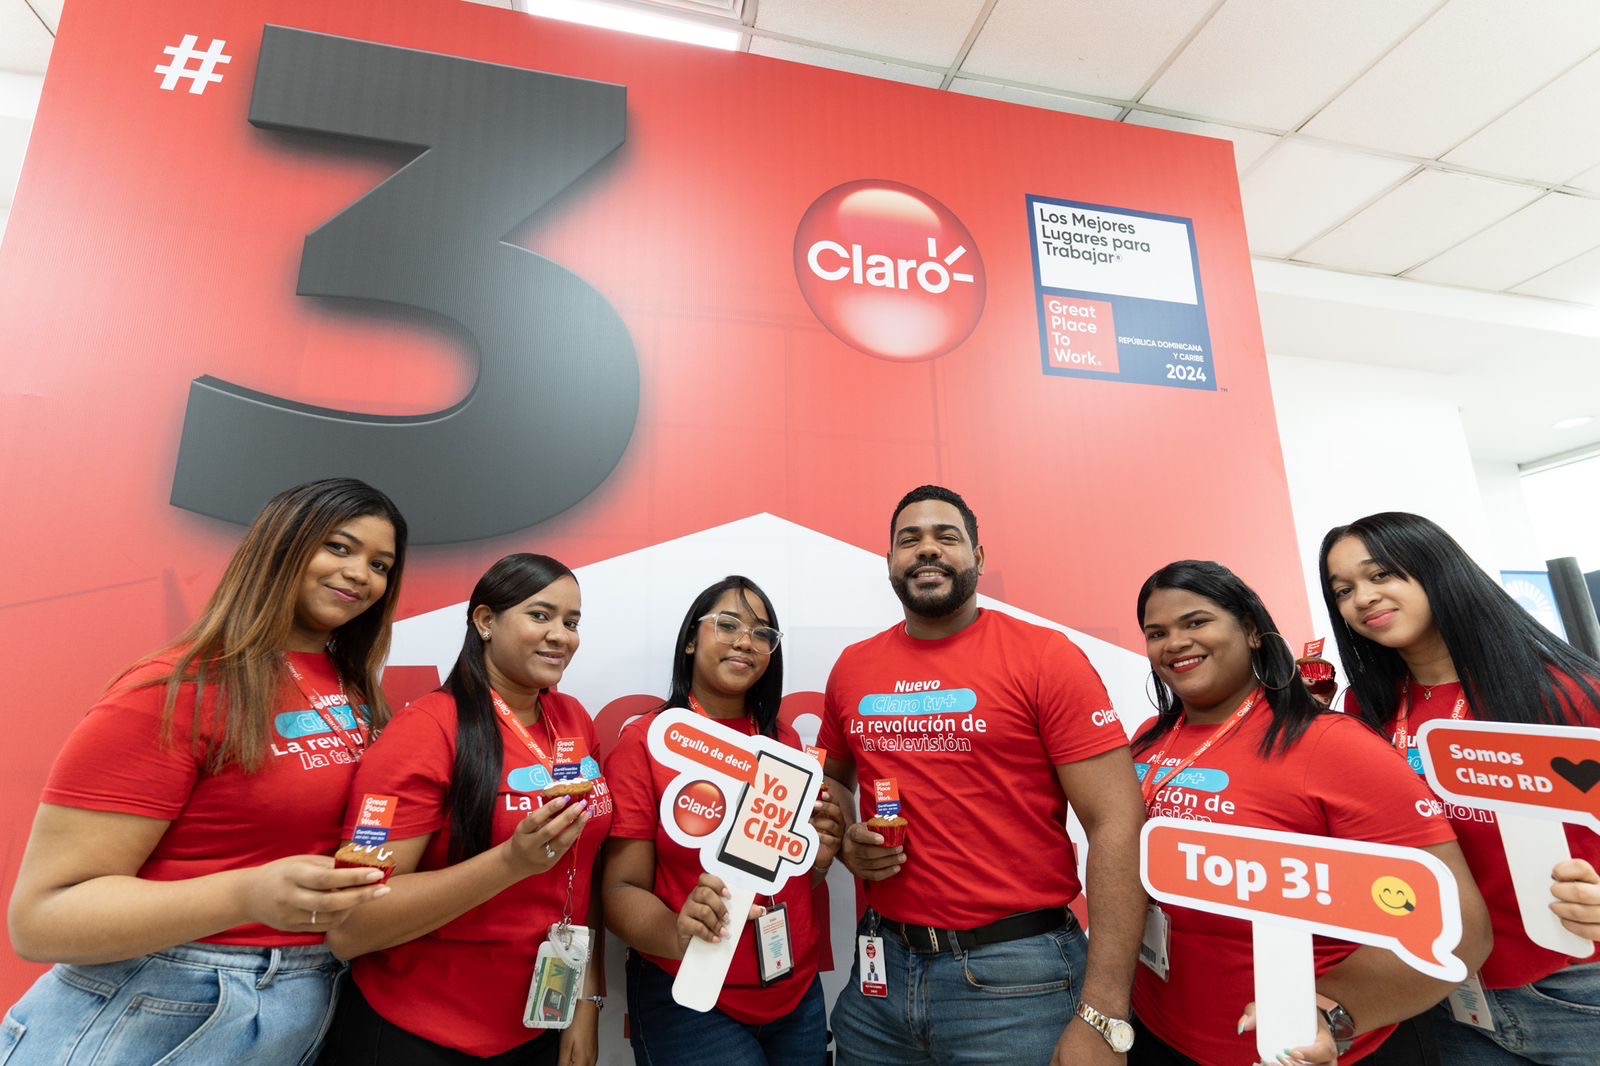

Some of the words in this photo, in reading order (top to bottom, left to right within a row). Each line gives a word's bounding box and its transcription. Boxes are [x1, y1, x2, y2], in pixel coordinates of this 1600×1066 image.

[1040, 208, 1068, 225] Los
[1072, 213, 1136, 234] Mejores
[1042, 225, 1108, 247] Lugares
[1112, 237, 1151, 252] para
[808, 237, 974, 294] Claro
[1049, 300, 1096, 319] Great
[1052, 315, 1097, 334] Place
[1052, 332, 1071, 346] To
[1118, 336, 1157, 347] REPÚBLICA
[1158, 340, 1203, 352] DOMINICANA
[1173, 352, 1179, 360] Y
[1179, 353, 1204, 362] CARIBE
[1166, 364, 1207, 382] 2024
[894, 680, 940, 693] Nuevo
[872, 696, 920, 712] Claro
[850, 719, 864, 734] La
[868, 715, 956, 733] revolución
[961, 714, 987, 732] de
[270, 741, 304, 756] La
[670, 730, 709, 754] Orgullo
[710, 748, 724, 760] de
[725, 754, 752, 772] decir
[860, 734, 876, 751] la
[878, 734, 971, 751] televisión
[300, 752, 330, 770] la
[1449, 743, 1524, 765] Somos
[763, 773, 788, 801] Yo
[1455, 767, 1514, 788] Claro
[1517, 773, 1553, 793] RD
[505, 793, 532, 811] La
[678, 795, 723, 819] Claro
[1204, 795, 1235, 815] de
[751, 798, 793, 829] soy
[744, 817, 803, 857] Claro
[1177, 842, 1268, 901] Top
[1280, 857, 1332, 906] 3!
